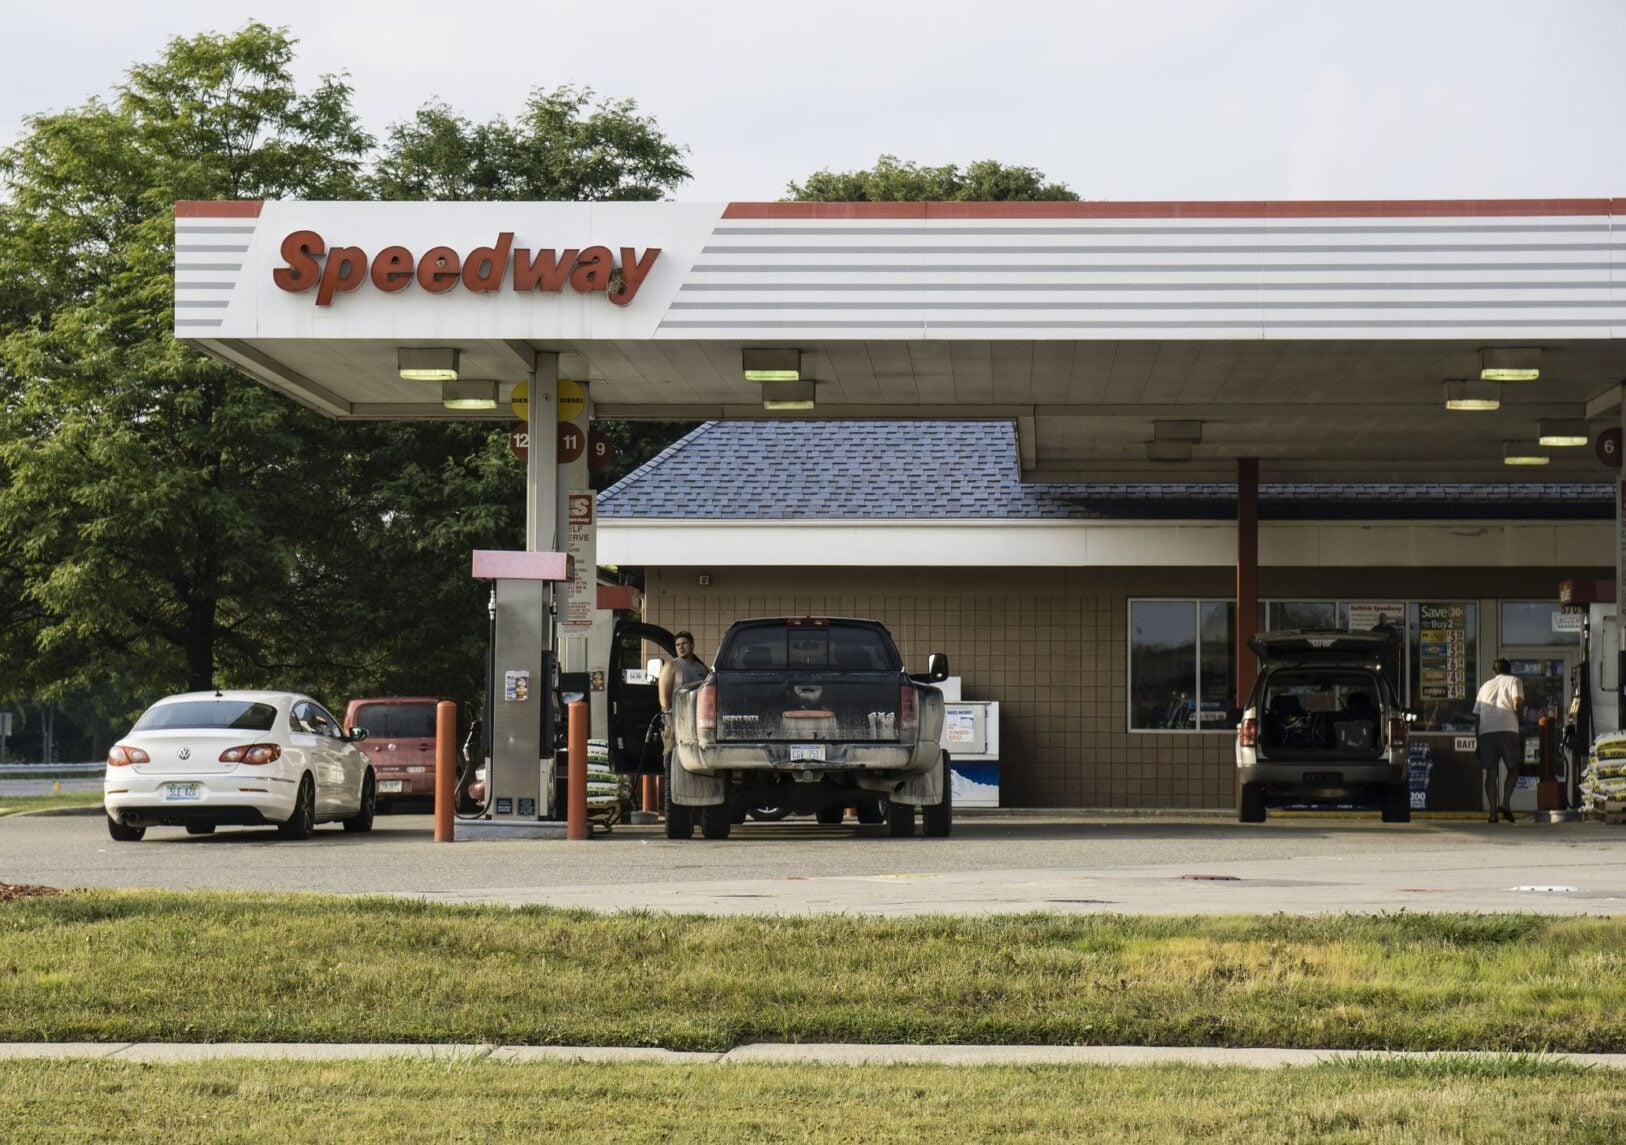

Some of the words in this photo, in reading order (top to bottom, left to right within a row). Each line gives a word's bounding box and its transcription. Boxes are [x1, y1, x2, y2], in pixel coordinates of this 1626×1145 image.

[273, 230, 662, 306] Speedway
[513, 433, 528, 448] 12
[563, 435, 577, 449] 11
[1604, 439, 1614, 454] 6
[595, 442, 605, 456] 9
[1421, 605, 1448, 618] Save
[1431, 619, 1447, 629] Buy
[1448, 619, 1453, 628] 2
[1456, 740, 1475, 749] BAIT
[1409, 792, 1426, 800] 200
